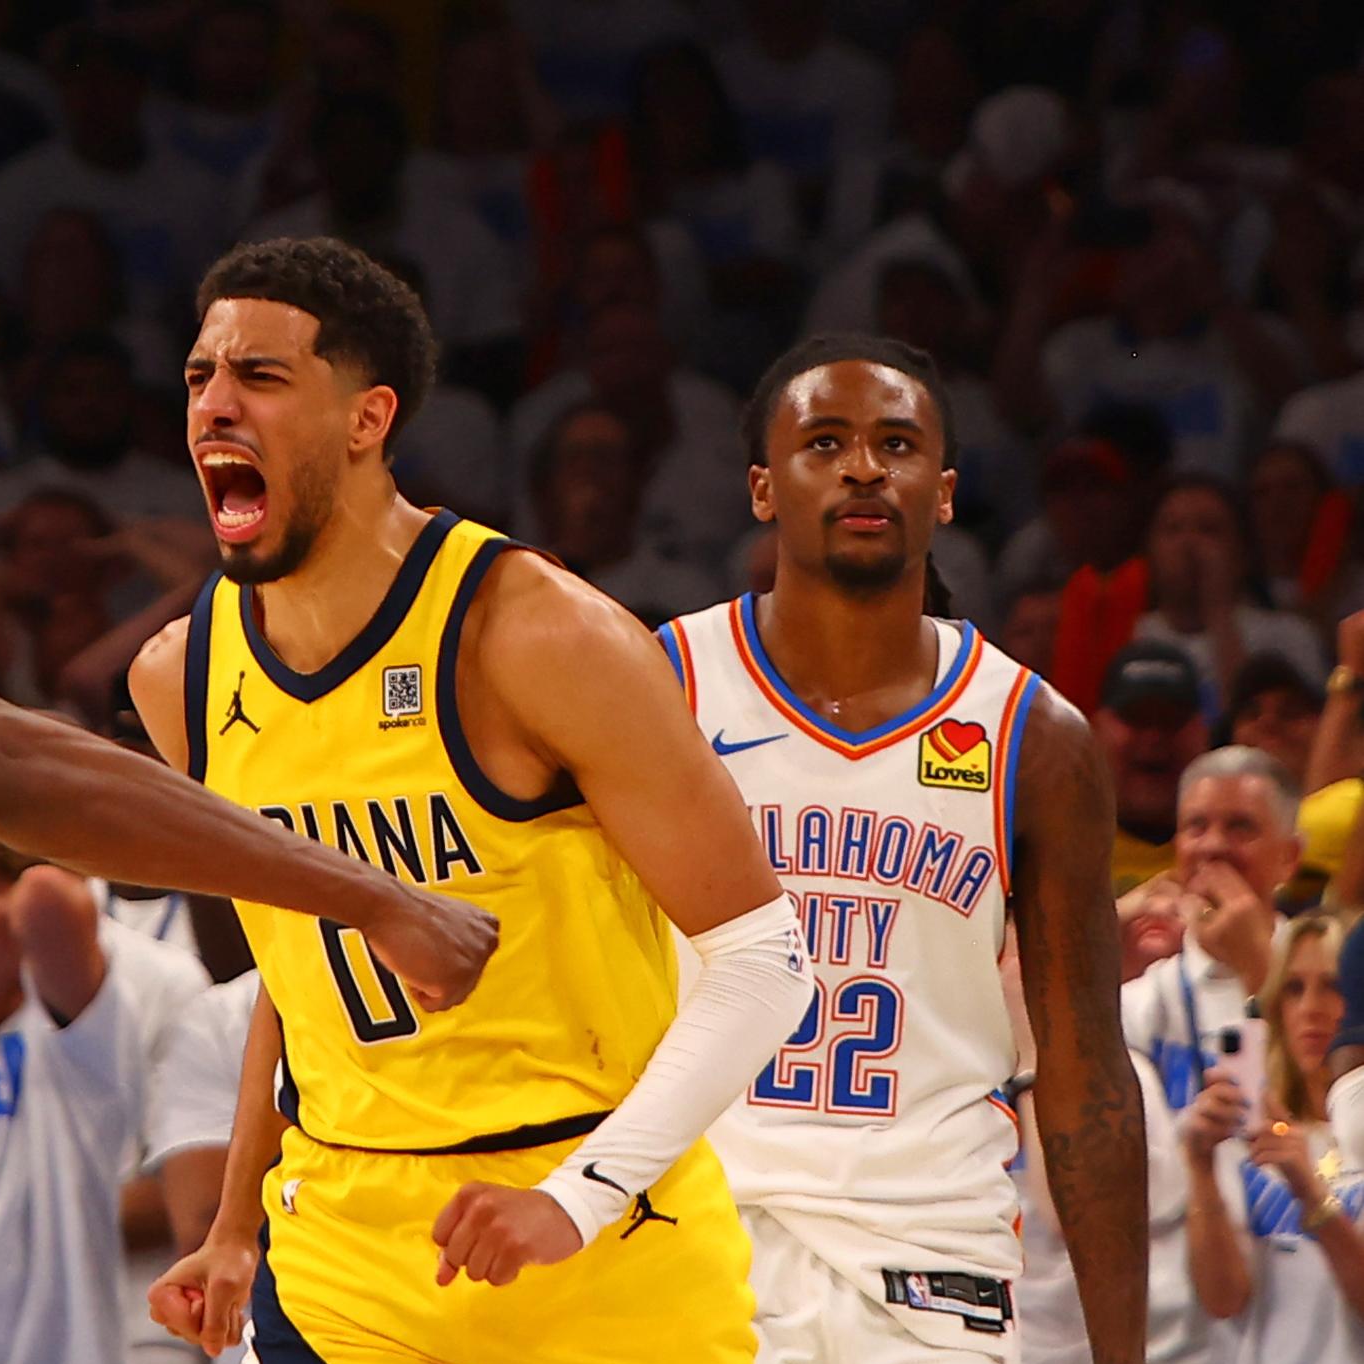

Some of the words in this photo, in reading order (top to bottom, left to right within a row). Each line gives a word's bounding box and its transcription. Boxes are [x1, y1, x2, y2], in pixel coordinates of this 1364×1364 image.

[758, 804, 997, 918] LAHOMA
[787, 889, 901, 969] ITY
[747, 974, 905, 1117] 22
